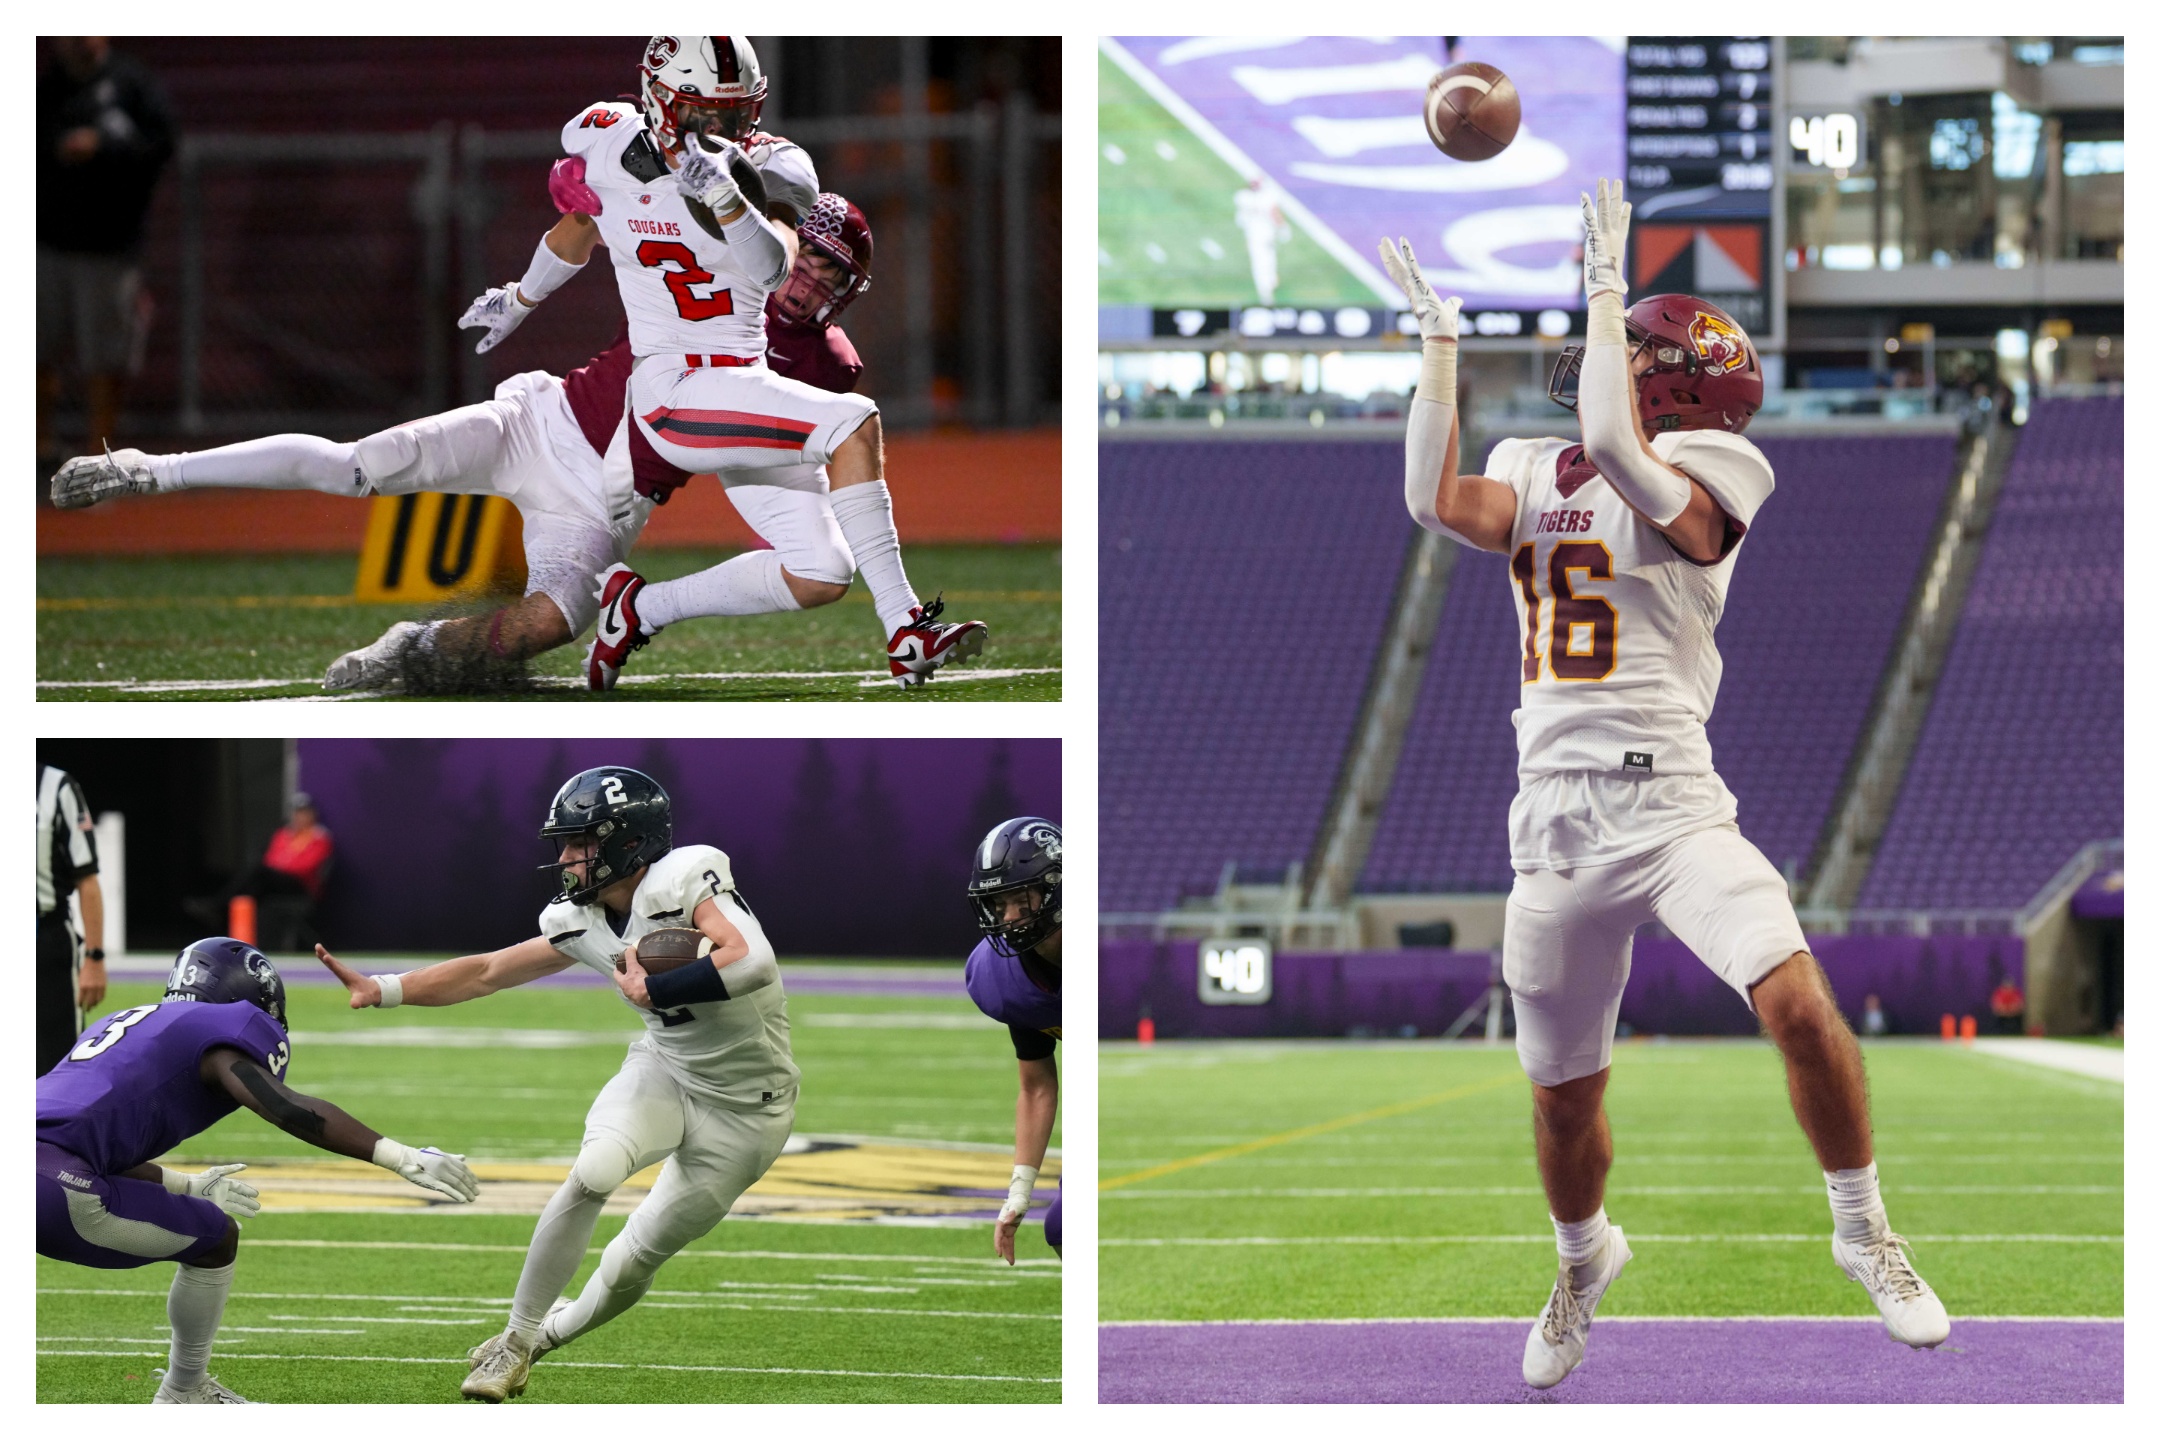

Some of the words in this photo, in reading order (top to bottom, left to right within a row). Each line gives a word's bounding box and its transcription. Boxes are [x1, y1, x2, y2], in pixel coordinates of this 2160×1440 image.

[715, 85, 745, 94] Riddell
[579, 108, 623, 129] 2
[1790, 113, 1857, 168] 40
[627, 218, 682, 236] COUGARS
[825, 233, 852, 255] Riddell
[635, 239, 735, 323] 2
[1535, 509, 1595, 534] TIGERS
[1510, 538, 1619, 686] 16
[1632, 754, 1644, 764] M
[601, 776, 628, 805] 2
[182, 964, 198, 986] 3
[1204, 946, 1265, 994] 40
[68, 1003, 162, 1062] 3
[267, 1041, 291, 1076] 3
[57, 1170, 93, 1189] TROJANS
